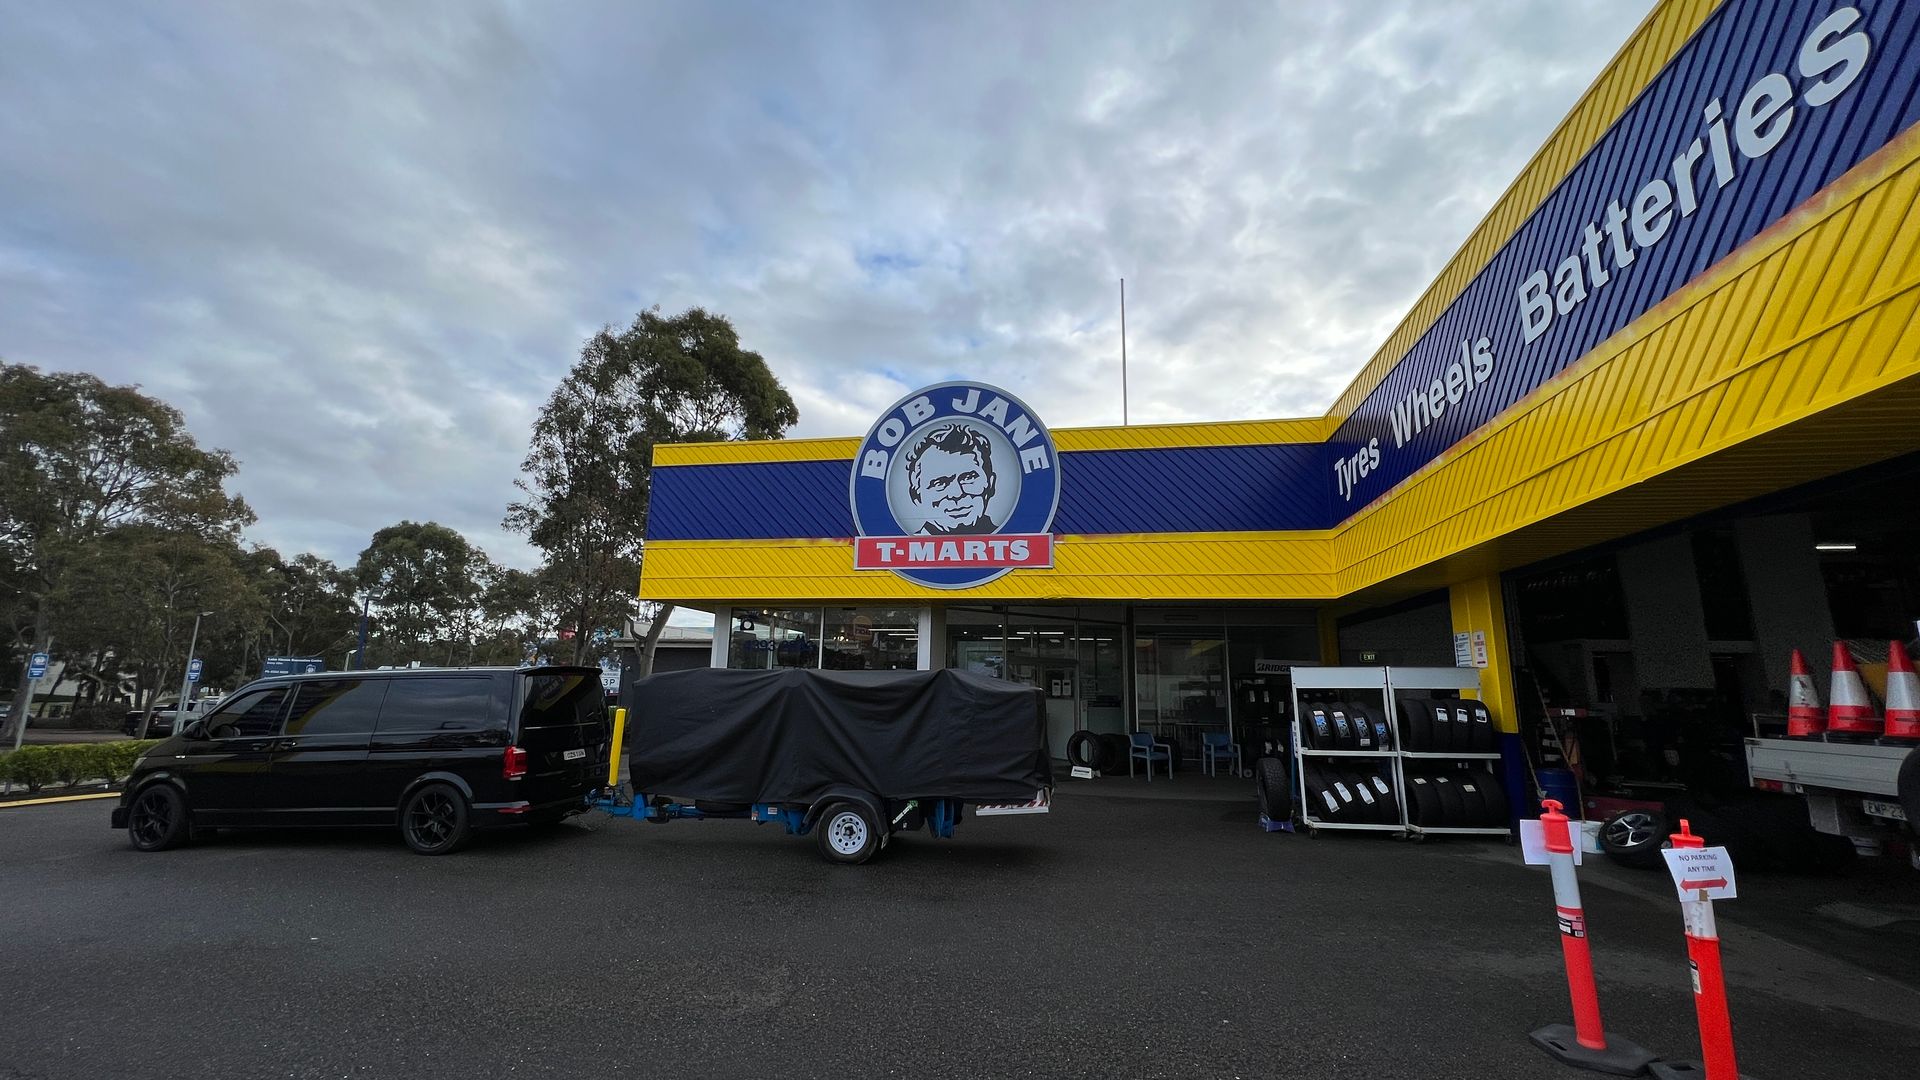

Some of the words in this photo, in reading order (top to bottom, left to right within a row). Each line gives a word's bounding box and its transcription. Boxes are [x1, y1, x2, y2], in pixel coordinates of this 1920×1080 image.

[1334, 437, 1380, 501] Tyres
[1390, 336, 1494, 449] Wheels
[1518, 6, 1871, 346] Batteries
[860, 395, 936, 480] BOB
[951, 389, 1050, 474] JANE
[876, 539, 1030, 563] T-MARTS
[1363, 653, 1375, 661] EXIT
[1256, 662, 1297, 672] BRIDGE
[602, 678, 616, 687] 3P
